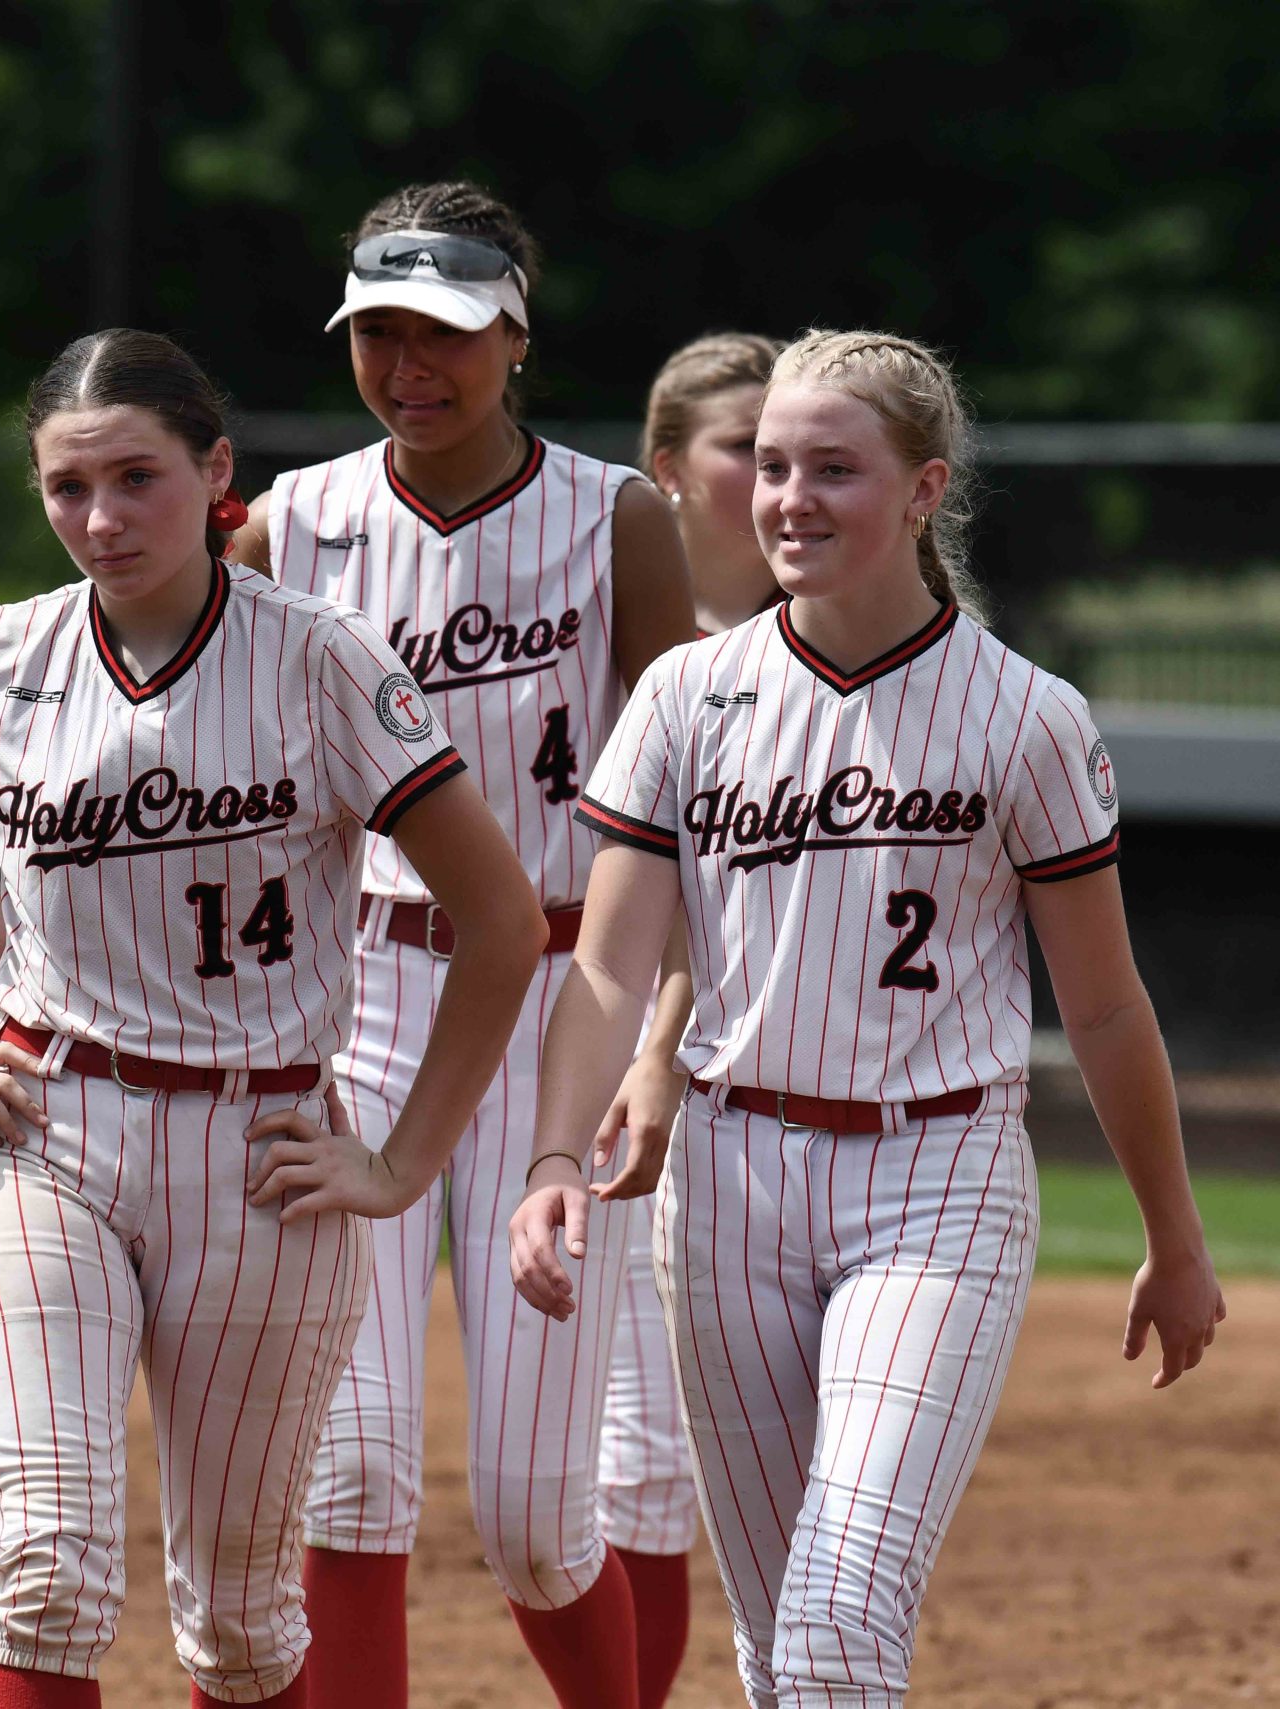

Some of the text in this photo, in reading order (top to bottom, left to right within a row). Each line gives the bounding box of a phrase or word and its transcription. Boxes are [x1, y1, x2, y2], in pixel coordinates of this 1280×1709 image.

[529, 703, 580, 806] 4
[184, 876, 296, 981] 14
[877, 888, 940, 994] 2
